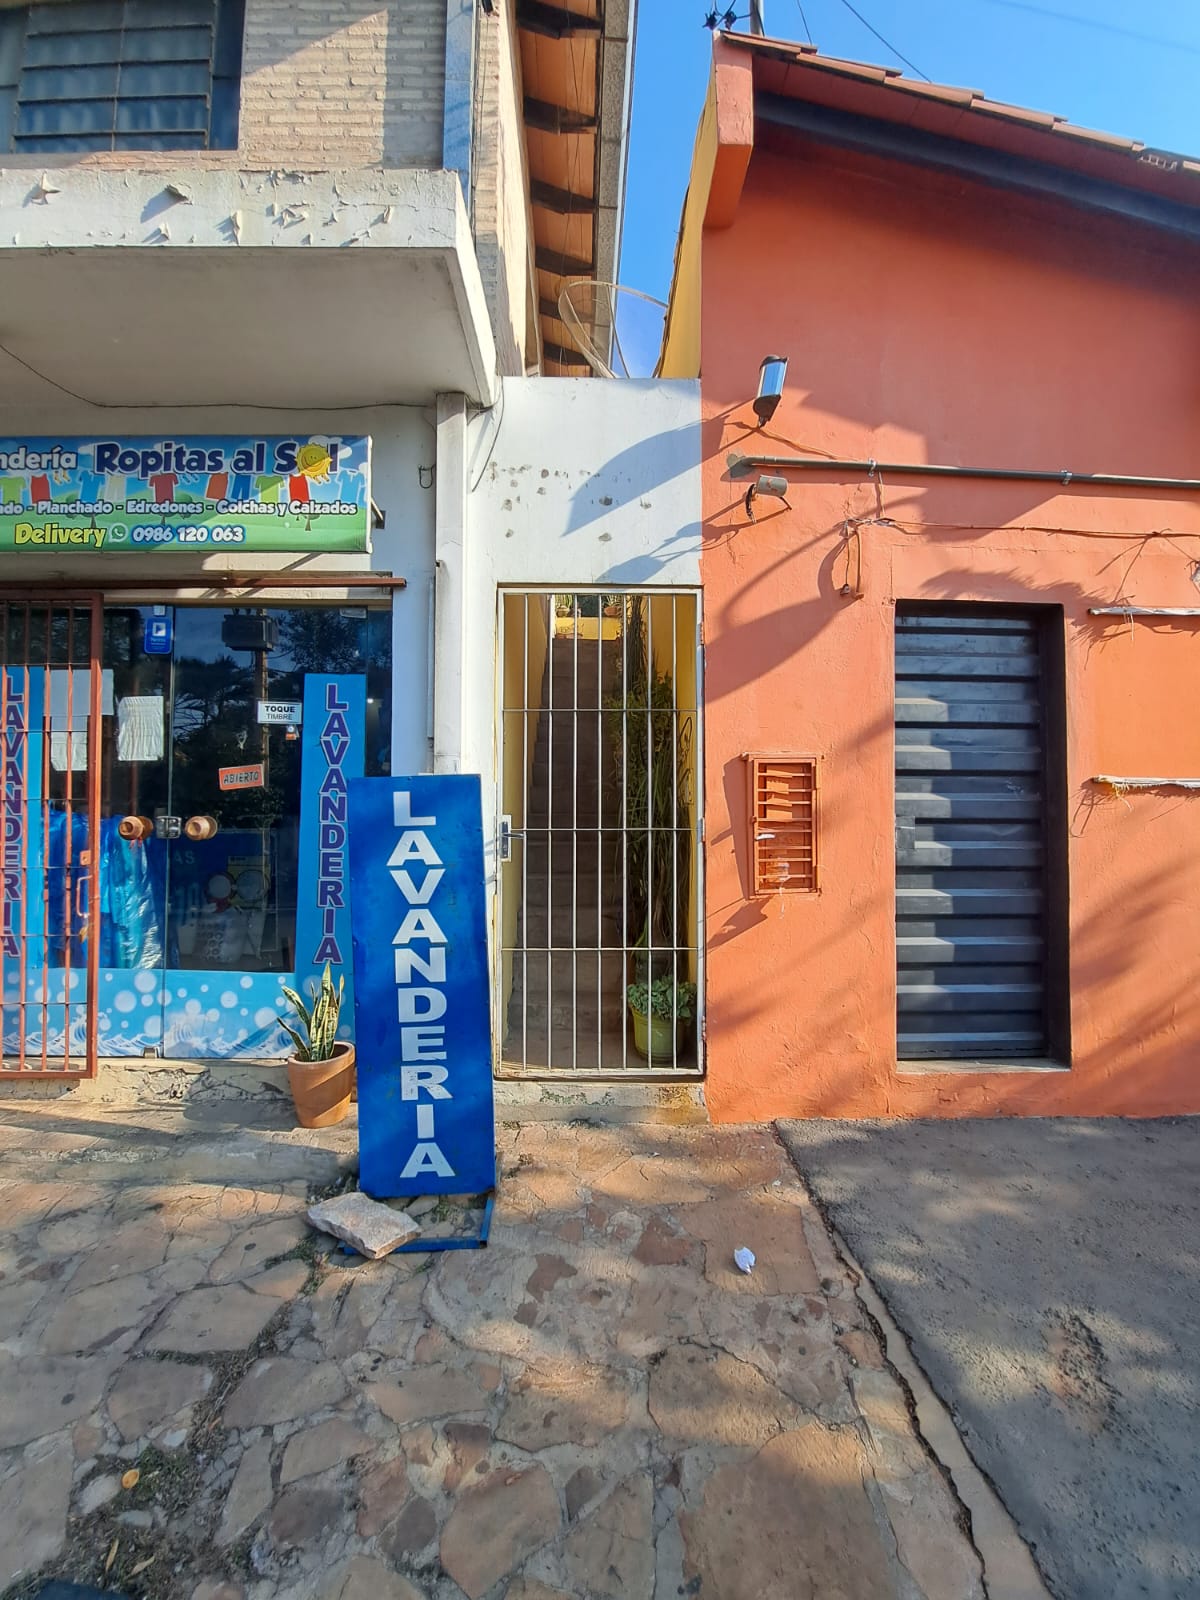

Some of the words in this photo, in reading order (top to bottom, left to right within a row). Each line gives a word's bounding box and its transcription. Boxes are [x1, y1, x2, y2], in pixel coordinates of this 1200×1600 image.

[95, 442, 223, 477] Ropitas
[231, 442, 266, 474] al
[37, 500, 112, 515] Planchado
[126, 501, 203, 515] Edredones
[216, 500, 276, 515] Colchas
[277, 503, 287, 517] y
[289, 501, 357, 515] Calzados
[15, 523, 107, 547] Delivery
[132, 526, 173, 542] 0986
[177, 526, 208, 542] 120
[211, 526, 244, 542] 063
[265, 705, 296, 713] TOQUE
[267, 713, 293, 721] TIMBRE
[223, 771, 259, 785] ABIERTO
[314, 683, 348, 964] LAVANDERIA
[386, 791, 455, 1178] LAVANDERIA
